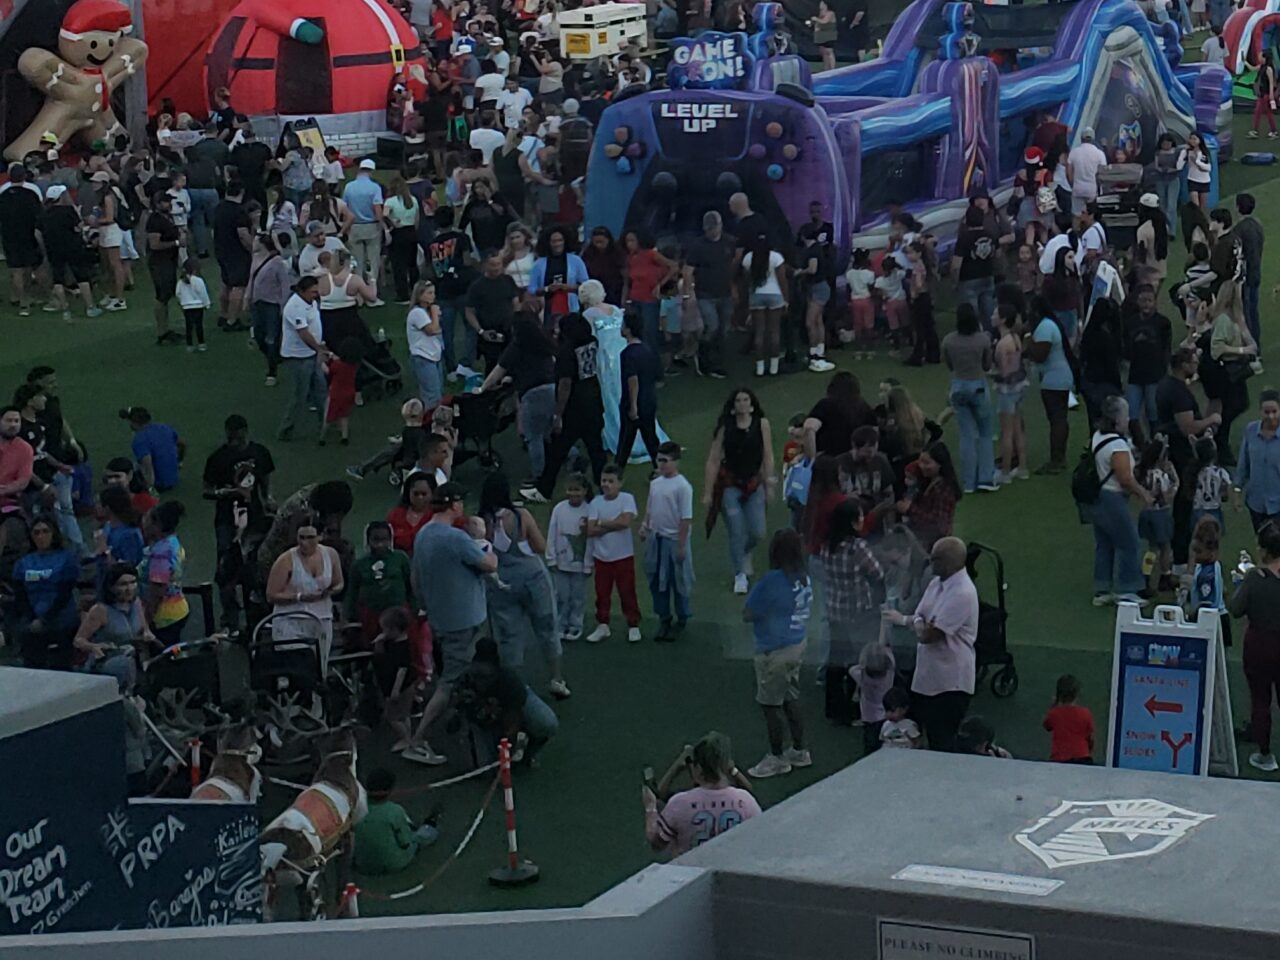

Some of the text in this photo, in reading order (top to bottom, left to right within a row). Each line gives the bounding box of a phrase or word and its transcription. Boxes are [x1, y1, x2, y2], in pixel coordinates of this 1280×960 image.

[674, 38, 737, 65] GAME
[703, 56, 745, 82] ON!
[661, 103, 738, 118] LEVEL
[683, 119, 717, 133] UP
[6, 818, 48, 858] Our
[120, 814, 186, 888] PRPA
[0, 844, 67, 903] Dream
[6, 877, 65, 924] Team
[884, 937, 933, 953] PLEASE
[936, 942, 957, 955] NO
